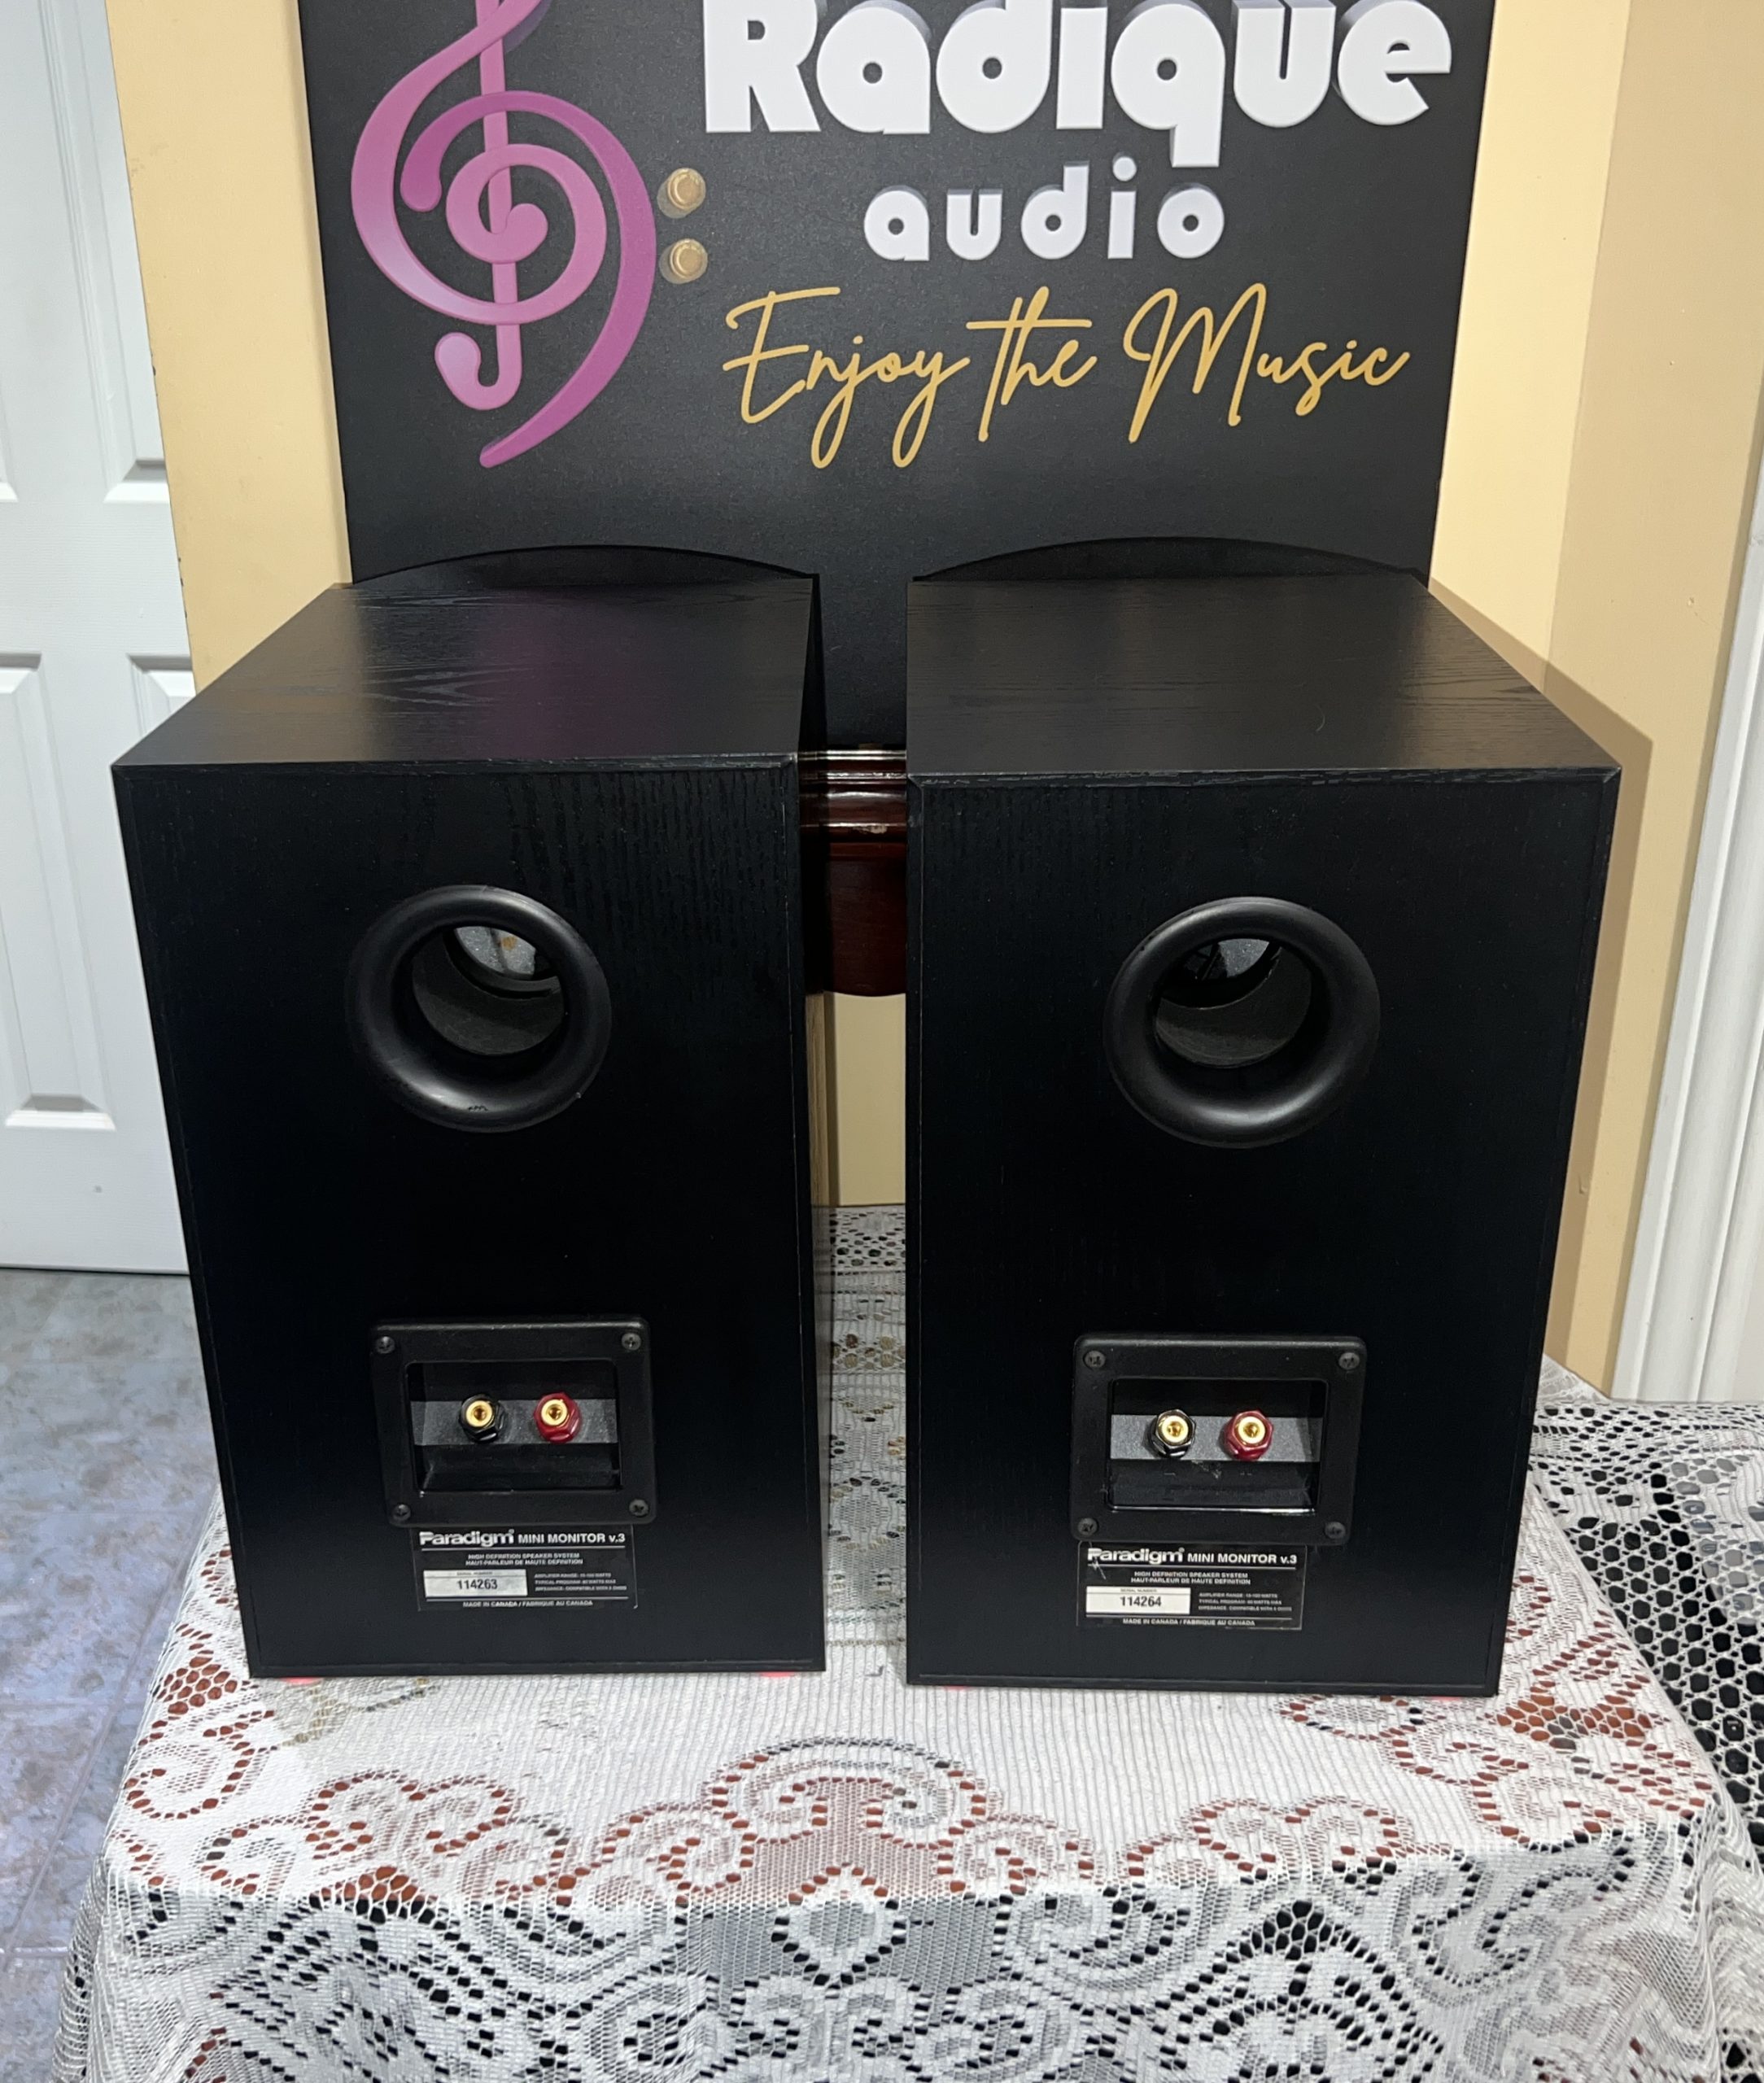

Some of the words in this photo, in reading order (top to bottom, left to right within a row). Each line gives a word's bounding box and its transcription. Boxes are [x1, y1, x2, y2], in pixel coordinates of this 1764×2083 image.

[705, 0, 1452, 169] Radique
[864, 152, 1225, 261] audio
[723, 286, 970, 469] Enjoy
[1123, 282, 1411, 443] Music
[419, 1530, 514, 1547] Paradigm
[517, 1534, 544, 1544] MINI
[548, 1533, 605, 1544] MONITOR
[609, 1533, 626, 1544] v.3
[1087, 1548, 1185, 1565] Paradigm
[1187, 1552, 1215, 1563] MINI
[1217, 1553, 1277, 1563] MONITOR
[1280, 1555, 1297, 1564] v.3
[456, 1579, 498, 1590] 114263
[1120, 1596, 1162, 1607] 114264
